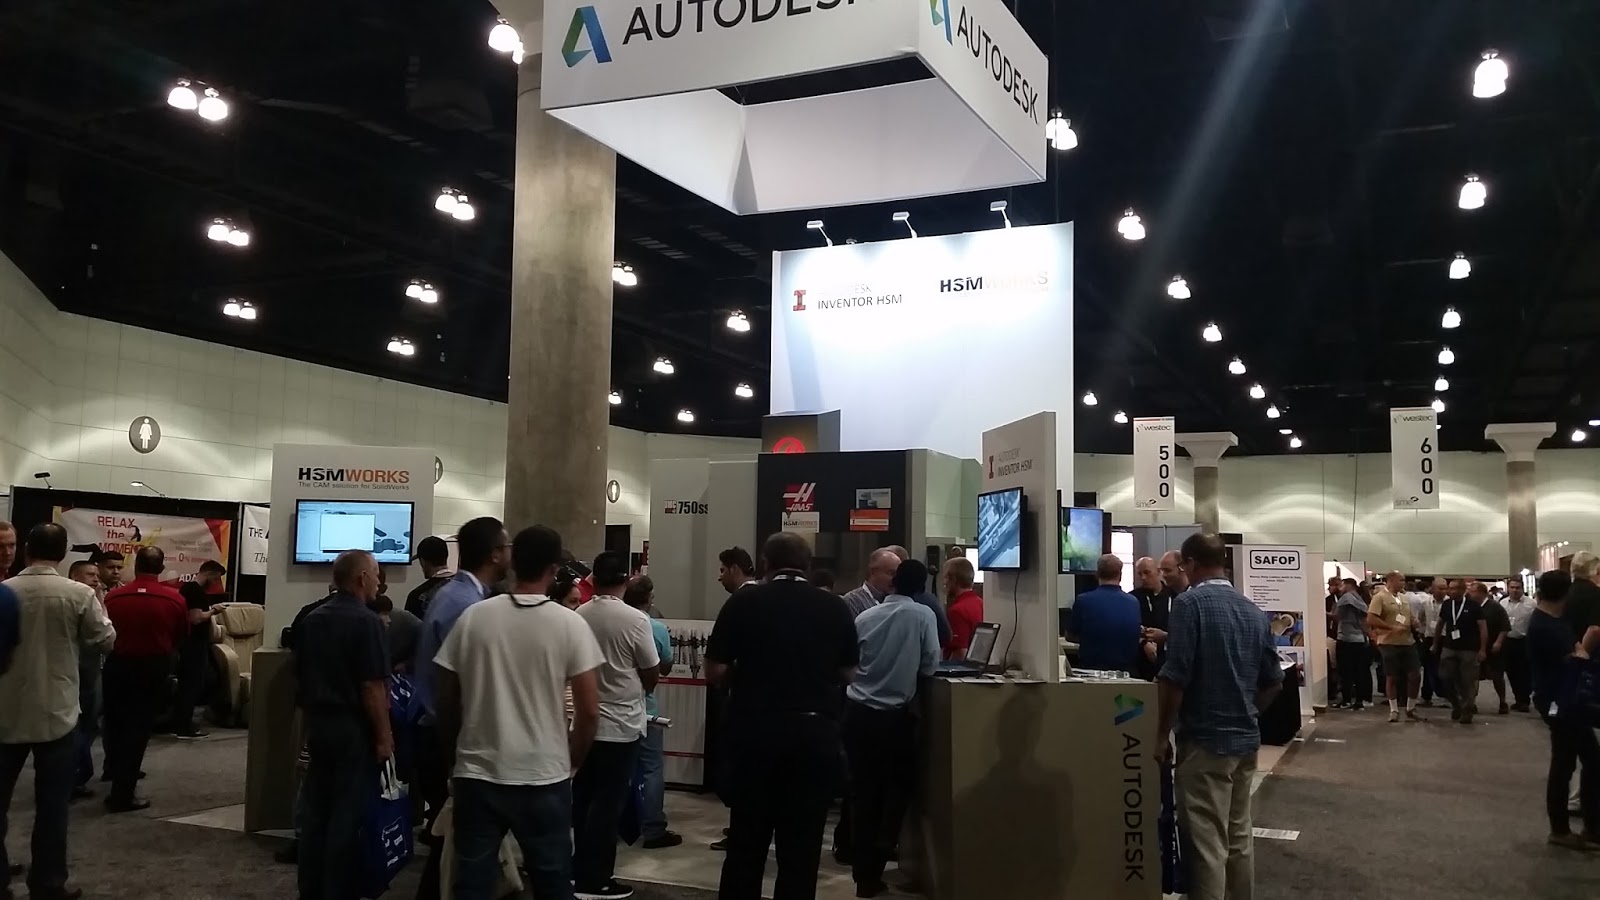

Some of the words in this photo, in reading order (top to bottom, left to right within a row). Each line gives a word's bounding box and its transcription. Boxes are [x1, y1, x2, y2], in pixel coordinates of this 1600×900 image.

[622, 0, 855, 45] AUTOD
[957, 6, 1039, 124] AUTODESK
[940, 270, 1049, 293] HSMWS
[817, 296, 873, 310] INVENTOR
[876, 294, 902, 306] HSM
[1402, 414, 1433, 422] westec
[998, 462, 1020, 477] INVENTOR
[1020, 459, 1033, 472] HSM
[298, 467, 410, 483] HSMWORKS
[372, 483, 410, 491] SolidWorks
[786, 503, 814, 512] HAAS
[97, 515, 135, 528] RELAX
[107, 529, 125, 539] the
[248, 527, 263, 539] THE
[99, 542, 144, 555] MOMEN
[254, 552, 268, 563] Th
[1254, 555, 1296, 565] SAFOP
[1122, 732, 1145, 882] AUTODESK
